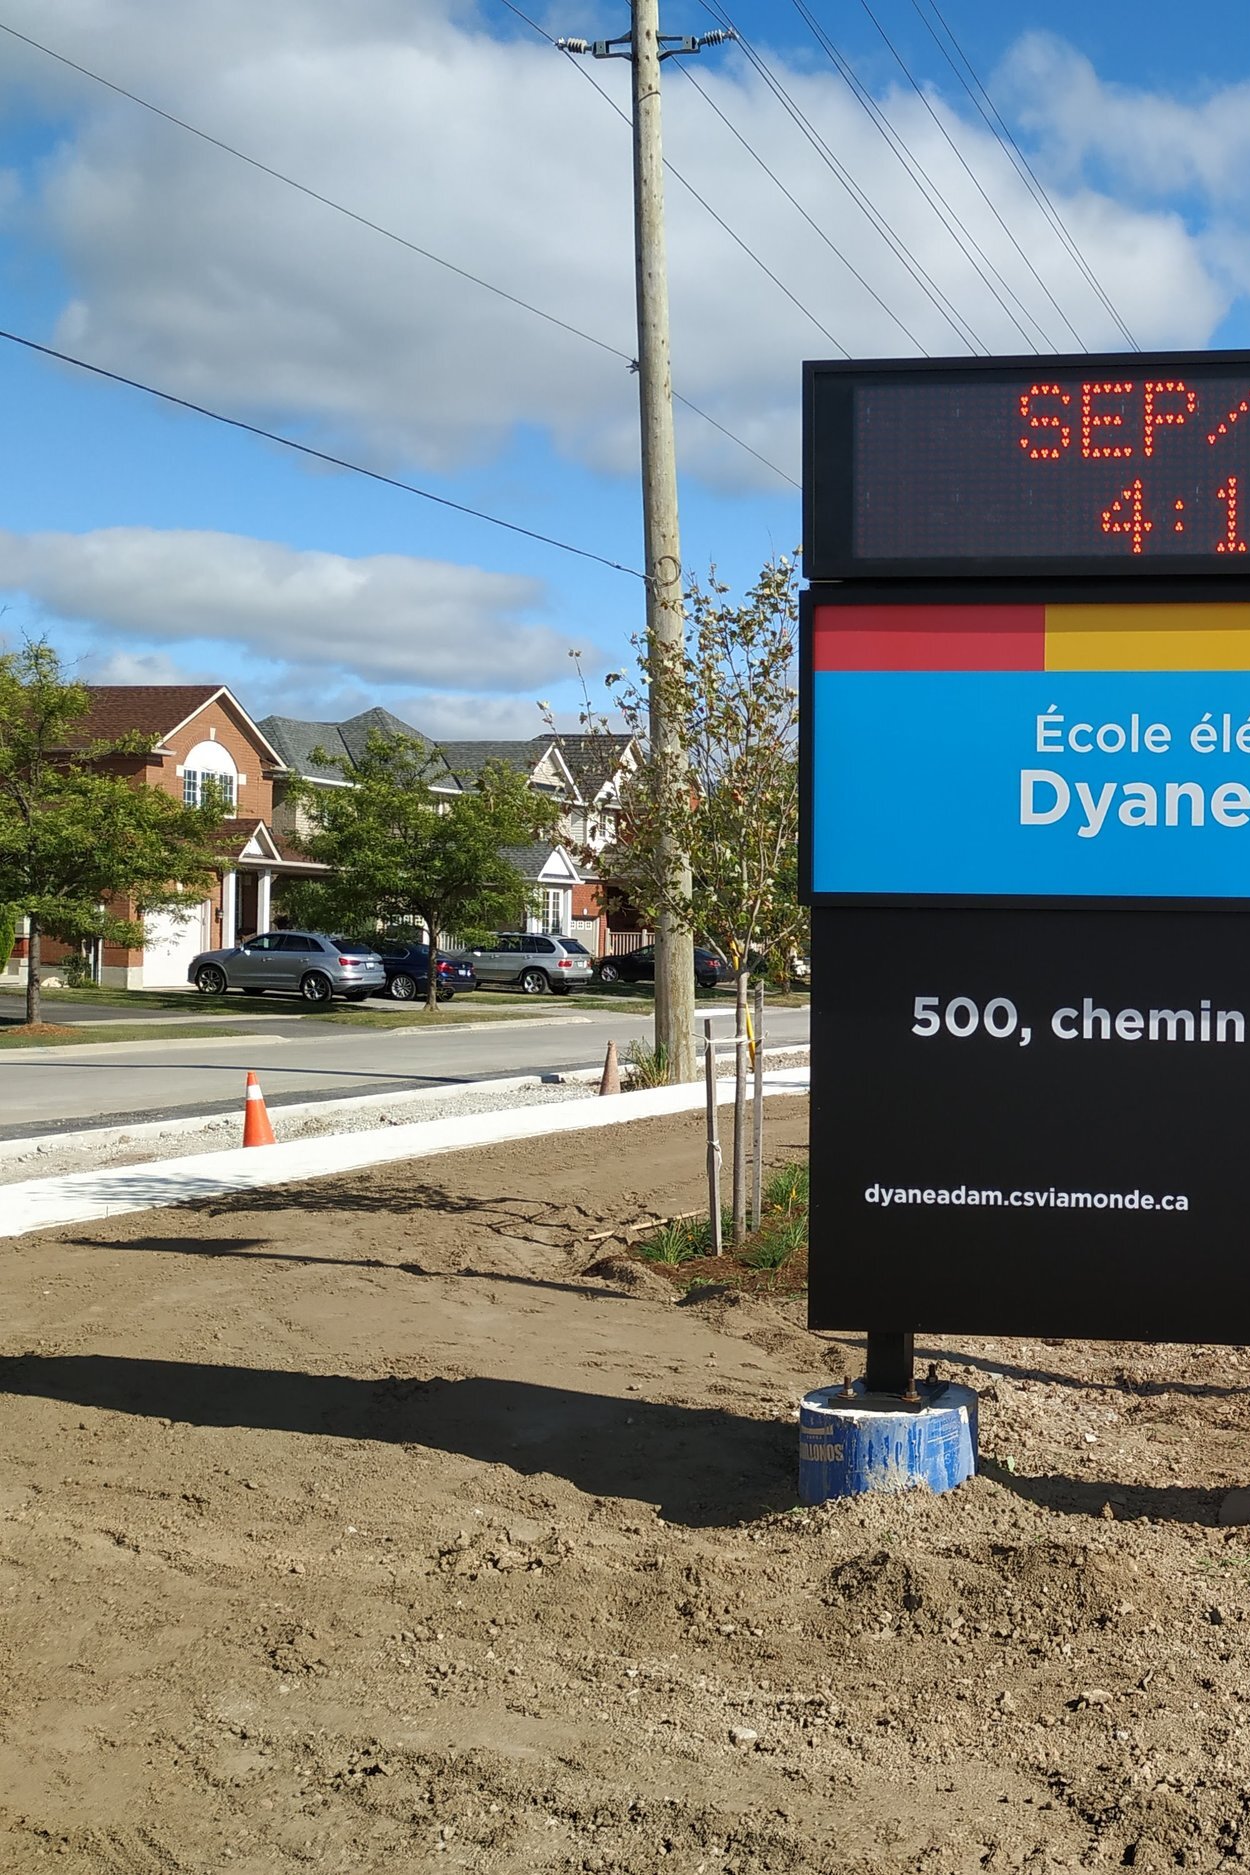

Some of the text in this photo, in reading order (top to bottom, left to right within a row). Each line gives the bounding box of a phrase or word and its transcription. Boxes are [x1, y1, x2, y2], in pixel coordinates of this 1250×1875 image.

[1036, 703, 1172, 753] École
[911, 996, 1032, 1047] 500,
[1051, 997, 1245, 1043] chemin
[864, 1183, 1189, 1211] dyaneadam.csviamonde.ca
